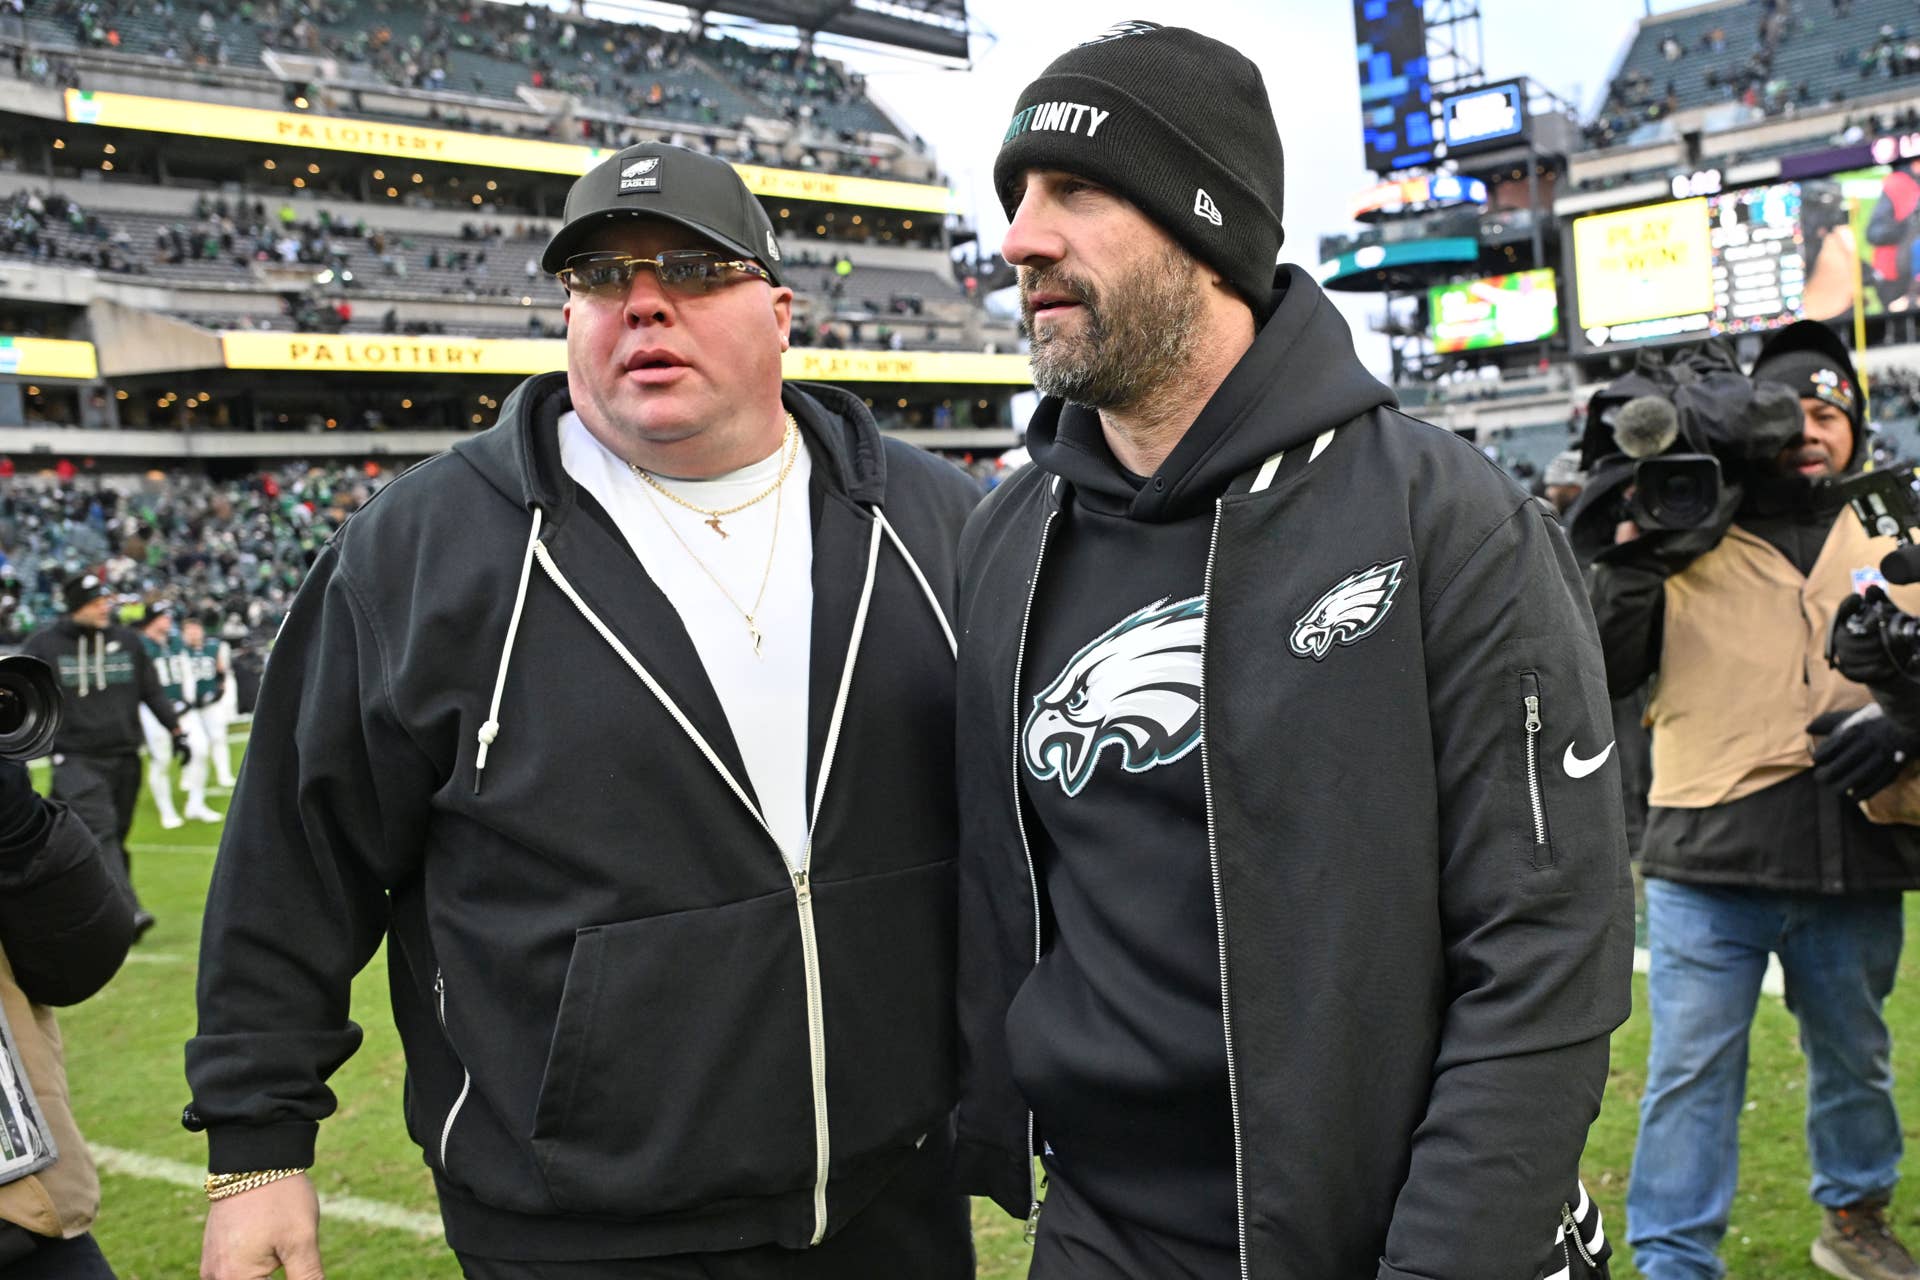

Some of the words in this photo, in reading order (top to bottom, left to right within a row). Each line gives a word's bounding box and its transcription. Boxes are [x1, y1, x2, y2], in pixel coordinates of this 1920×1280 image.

[277, 121, 315, 139] PA
[324, 127, 447, 151] LOTTERY
[621, 180, 656, 188] EAGLES
[290, 343, 333, 361] PA
[345, 345, 484, 364] LOTTERY
